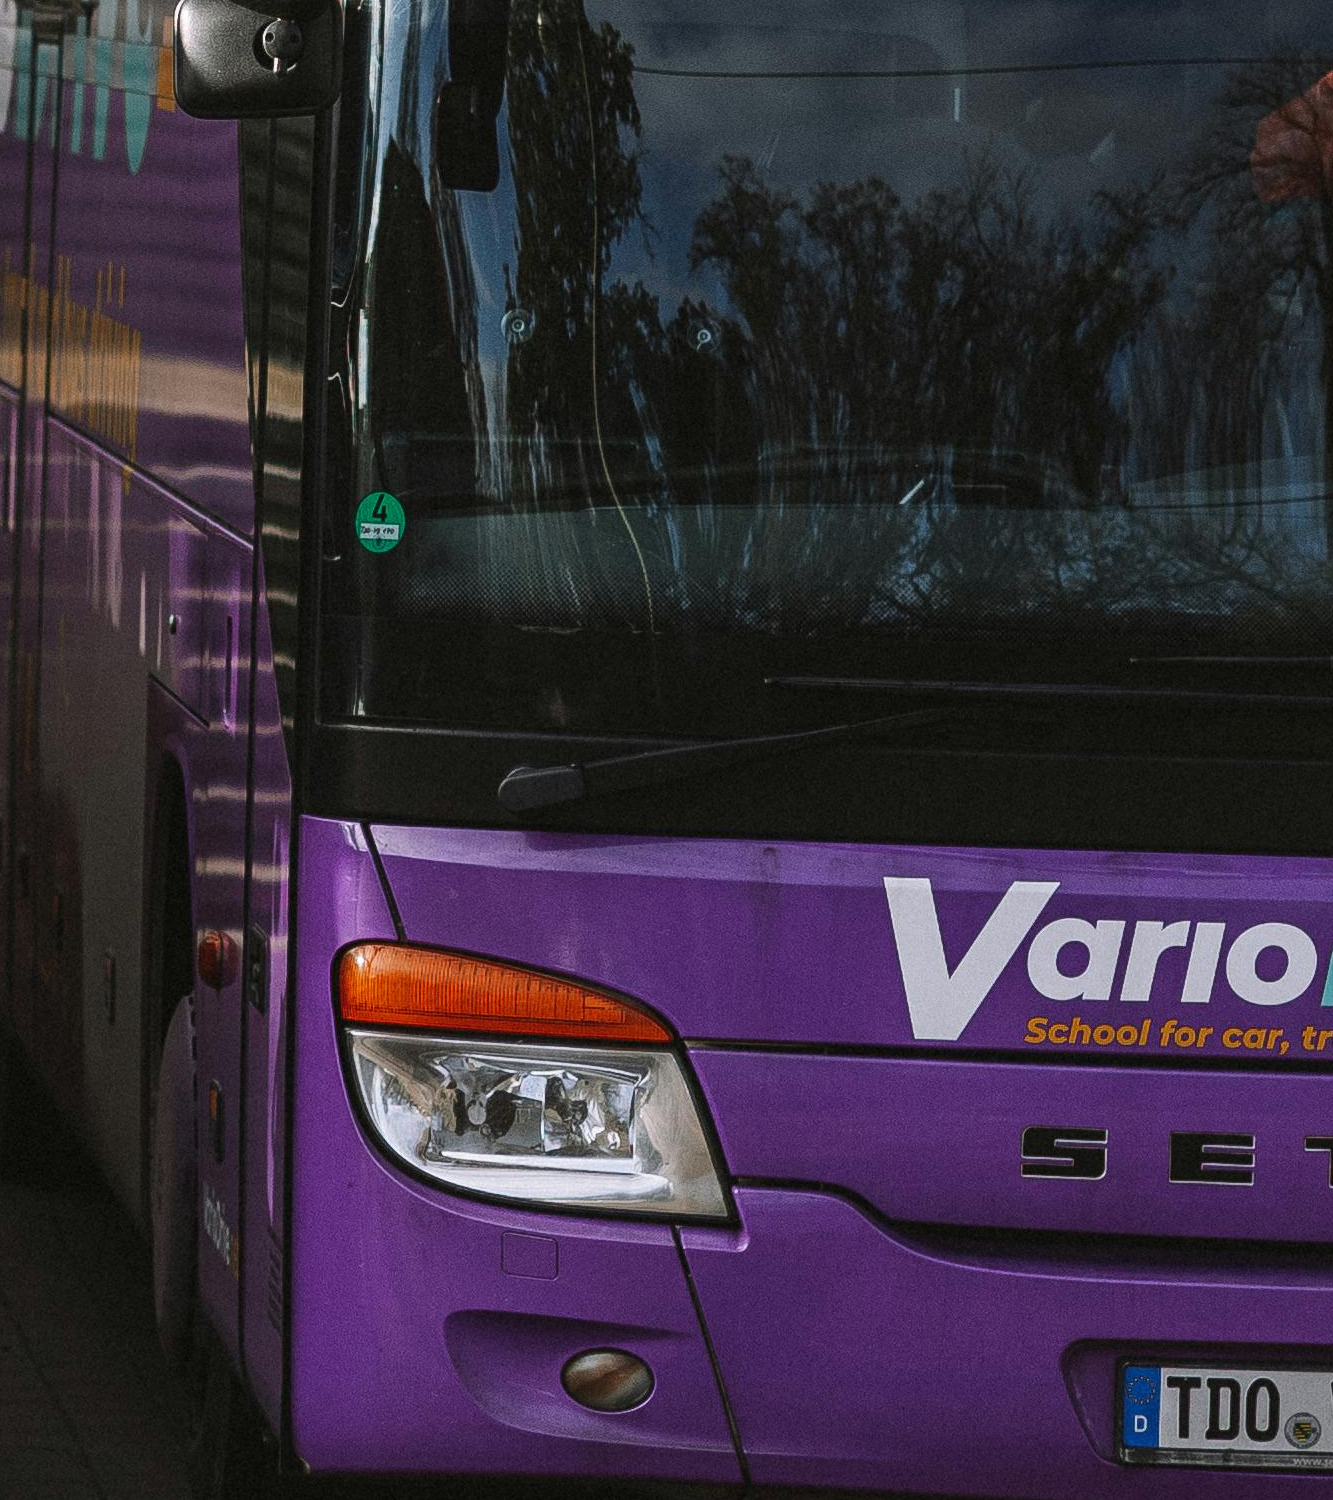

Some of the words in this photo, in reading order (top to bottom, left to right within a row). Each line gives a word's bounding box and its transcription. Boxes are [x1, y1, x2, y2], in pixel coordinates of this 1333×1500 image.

[372, 493, 388, 522] 4
[883, 876, 1333, 1041] Vario
[1023, 1016, 1152, 1046] School
[1160, 1019, 1214, 1048] for
[1222, 1026, 1290, 1056] car,
[1134, 1415, 1148, 1433] D
[1166, 1376, 1281, 1442] TDO
